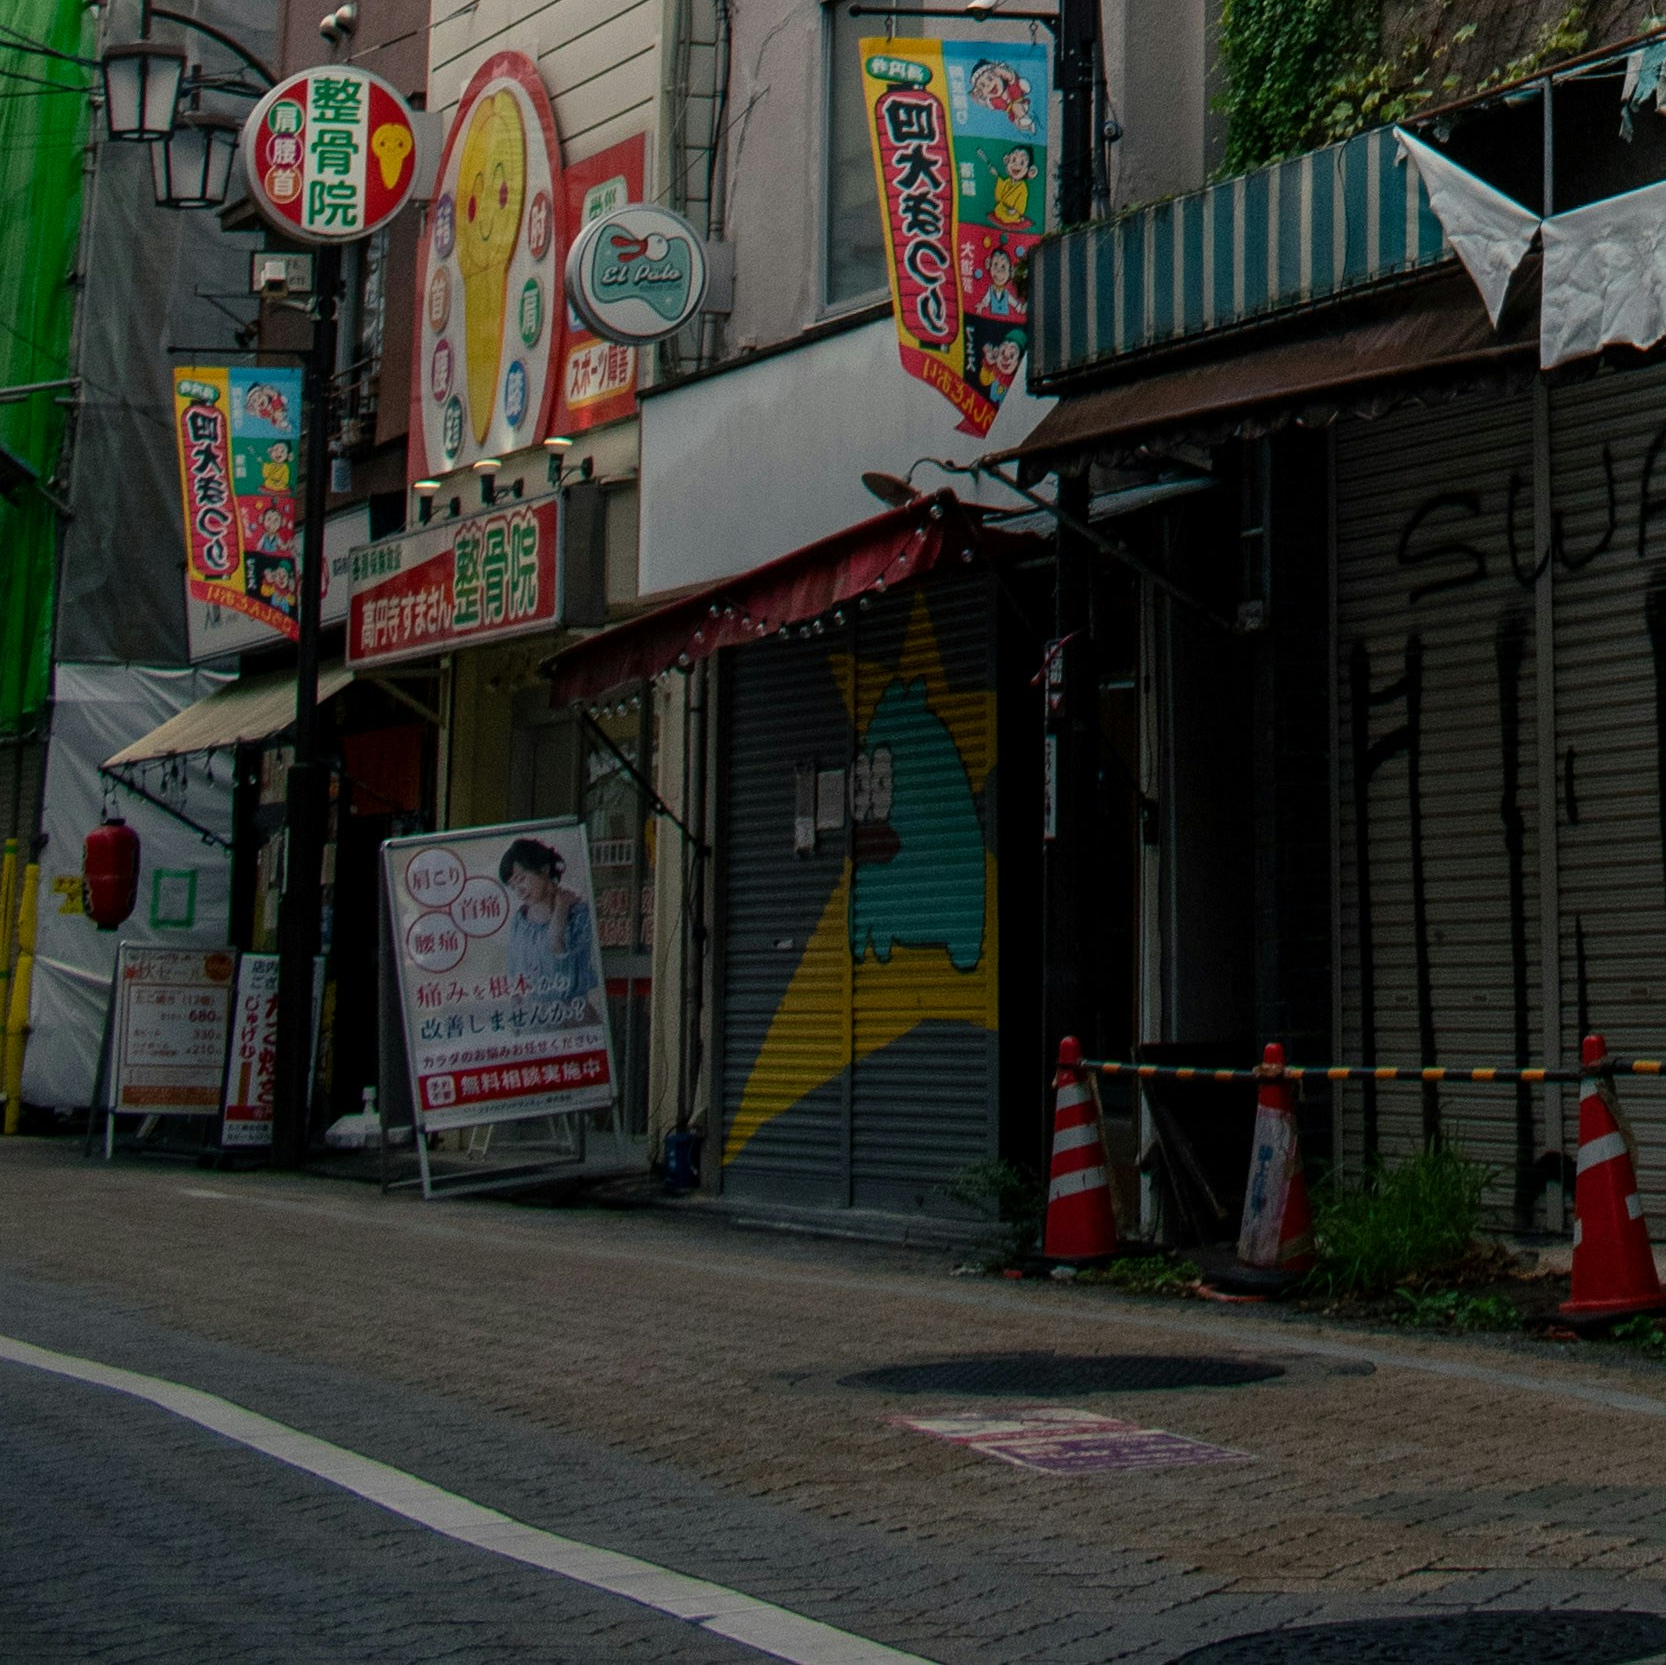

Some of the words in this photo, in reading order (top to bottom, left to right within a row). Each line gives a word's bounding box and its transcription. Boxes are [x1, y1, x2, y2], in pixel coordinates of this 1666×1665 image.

[307, 76, 362, 228] 整骨院
[601, 264, 629, 286] El
[412, 868, 461, 892] 肩こり
[460, 898, 500, 921] 首痛
[415, 930, 459, 954] 腰痛
[460, 1058, 601, 1097] 無料相談実施中
